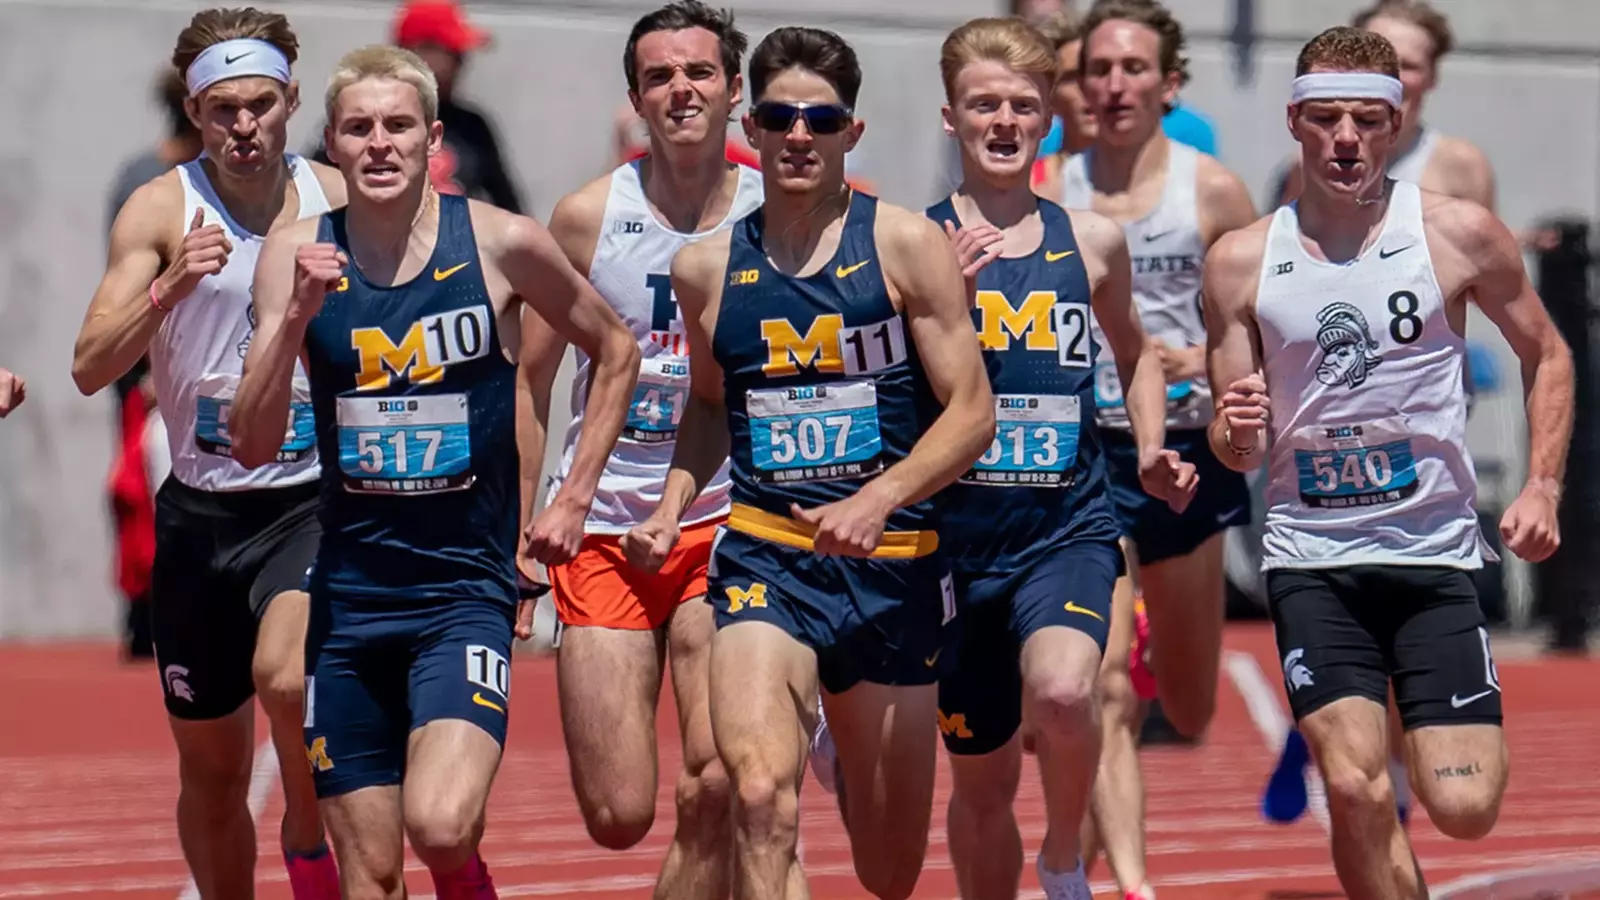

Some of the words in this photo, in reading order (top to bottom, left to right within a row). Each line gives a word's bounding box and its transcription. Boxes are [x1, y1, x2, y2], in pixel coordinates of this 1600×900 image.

[1133, 255, 1196, 273] TATE
[427, 312, 481, 362] 10
[976, 290, 1058, 351] M
[1062, 308, 1087, 362] 2
[1388, 290, 1423, 344] 8
[351, 321, 445, 391] M
[760, 313, 846, 378] M
[845, 323, 894, 372] 11
[636, 389, 683, 425] 41
[358, 430, 442, 473] 517
[770, 415, 852, 463] 507
[1312, 450, 1392, 491] 540
[725, 582, 768, 613] M
[472, 648, 508, 694] 10
